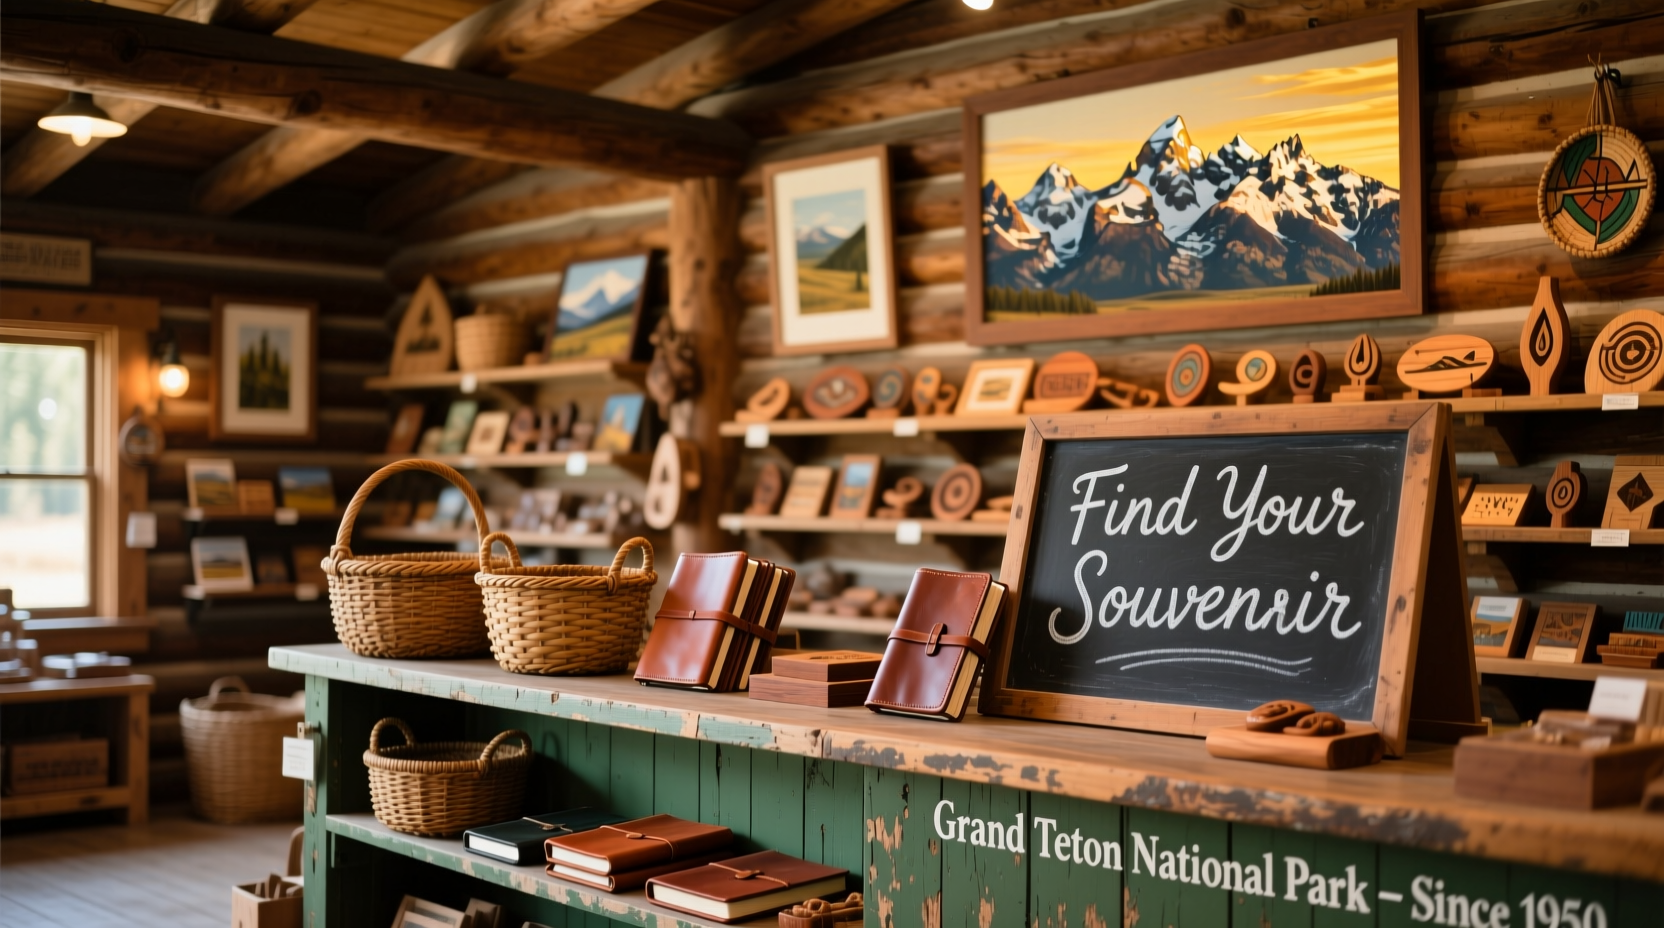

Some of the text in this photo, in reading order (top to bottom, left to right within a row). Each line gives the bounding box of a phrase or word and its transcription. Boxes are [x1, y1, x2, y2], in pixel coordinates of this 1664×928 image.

[1070, 464, 1365, 562] Find Your
[933, 799, 1026, 854] Grand
[1033, 816, 1123, 871] Teton
[1130, 831, 1276, 898] National
[1283, 856, 1371, 914] Park
[1410, 874, 1511, 928] Since
